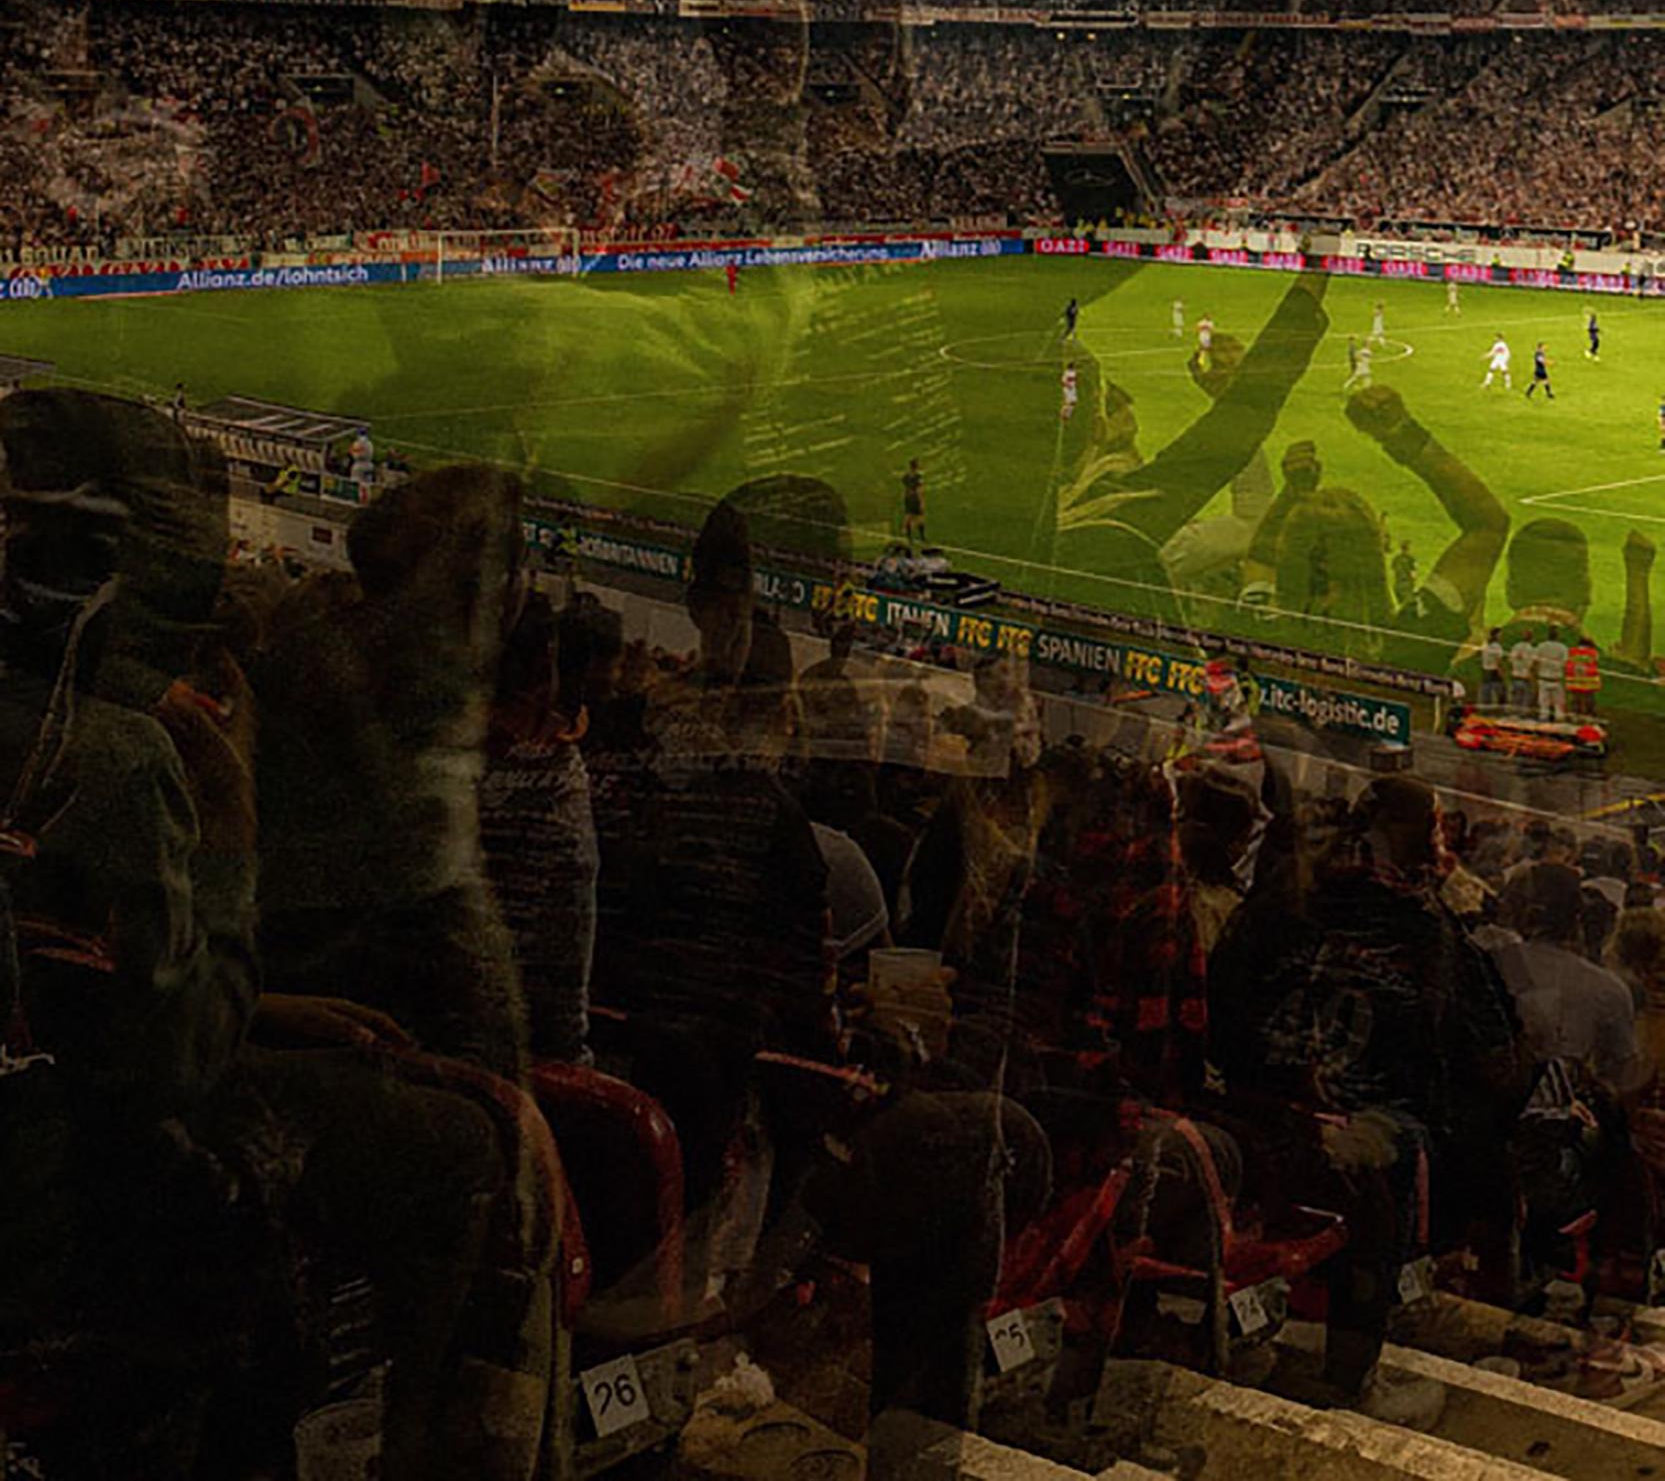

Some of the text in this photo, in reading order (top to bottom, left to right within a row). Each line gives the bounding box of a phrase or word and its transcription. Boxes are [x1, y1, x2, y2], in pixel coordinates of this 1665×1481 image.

[957, 615, 993, 648] ITC
[996, 623, 1033, 658] ITC
[1037, 633, 1121, 674] SPANIEN
[1124, 650, 1163, 685] ITC
[1167, 660, 1206, 696] ITC
